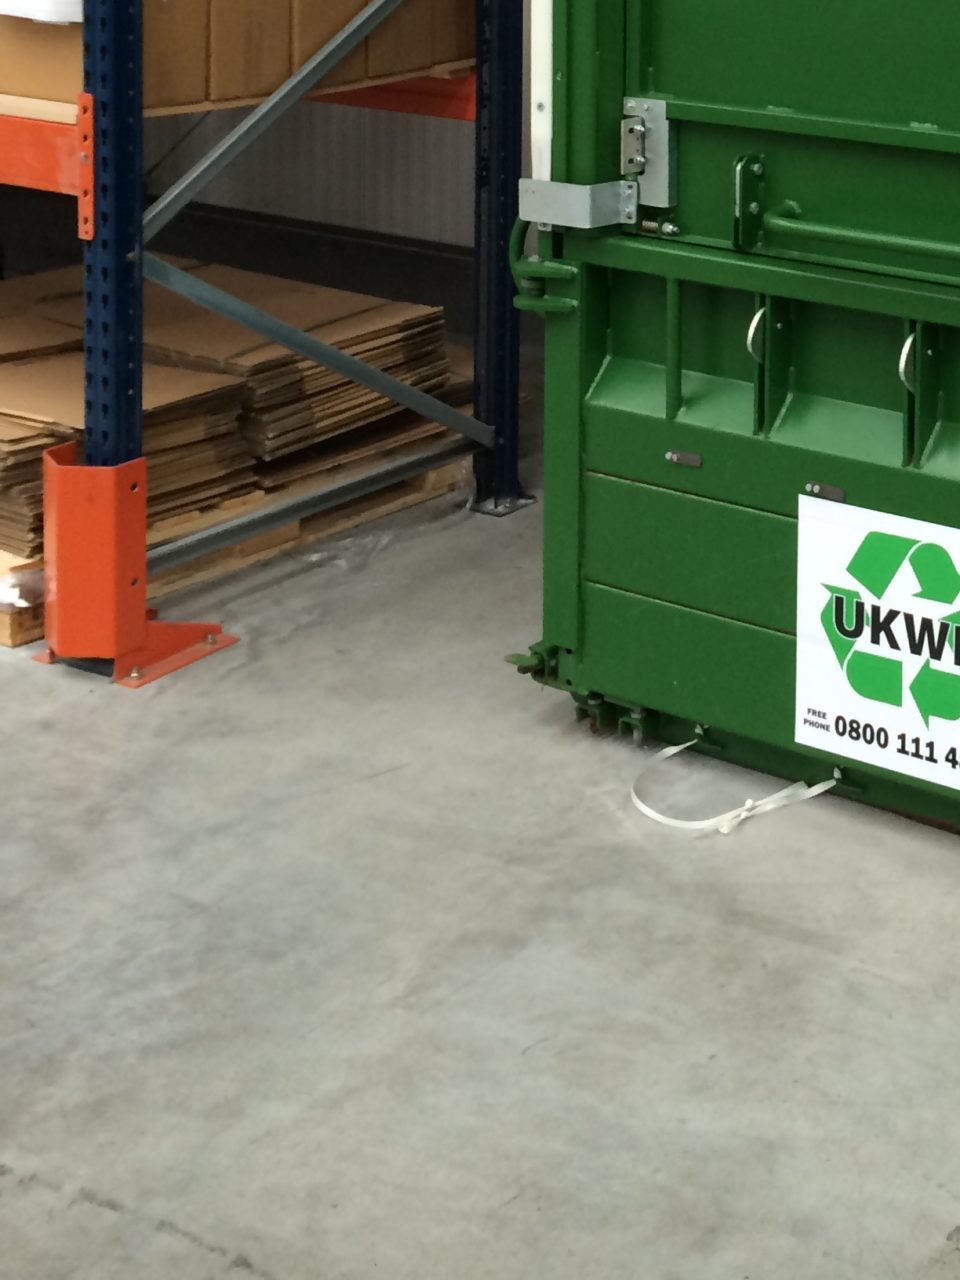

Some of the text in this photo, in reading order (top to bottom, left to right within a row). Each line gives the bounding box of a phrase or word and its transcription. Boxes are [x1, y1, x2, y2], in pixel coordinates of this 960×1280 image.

[806, 707, 828, 720] FREE
[803, 718, 831, 733] PHONE
[834, 715, 890, 749] 0800
[896, 732, 938, 764] 111
